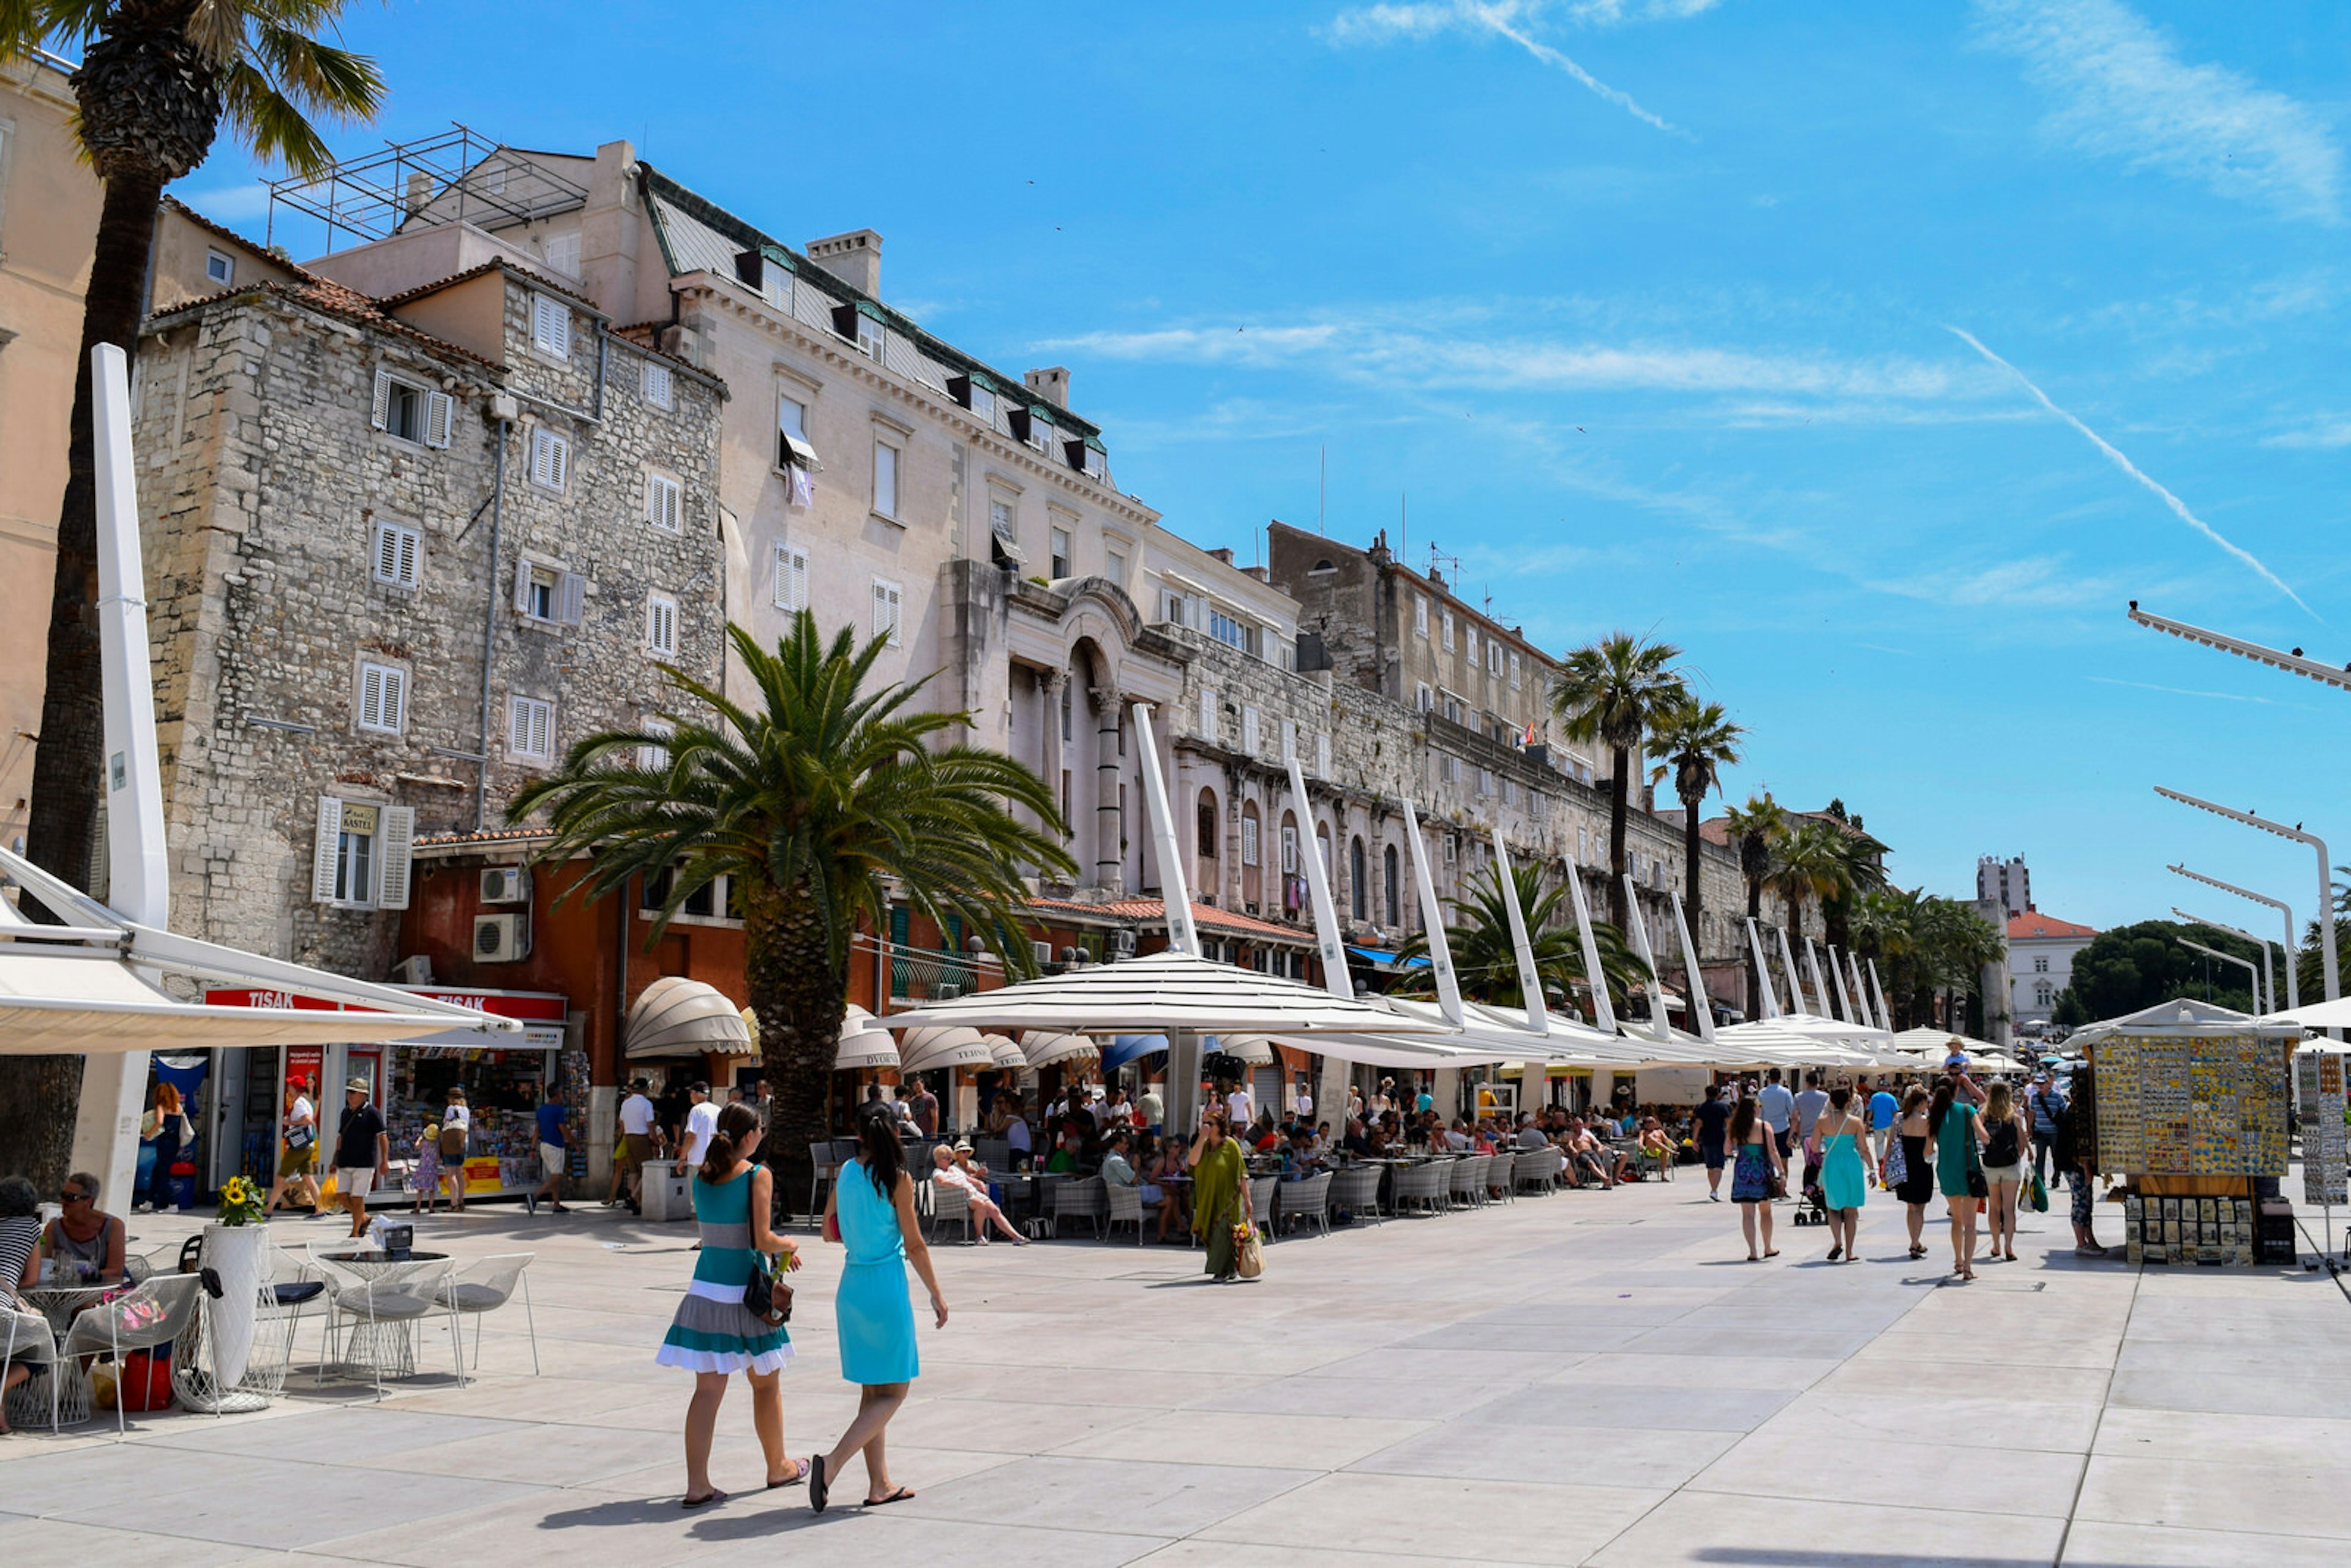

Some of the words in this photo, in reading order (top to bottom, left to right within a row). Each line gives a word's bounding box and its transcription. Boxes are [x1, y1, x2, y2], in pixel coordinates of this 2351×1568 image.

[343, 819, 372, 830] KASTEL
[249, 991, 294, 1009] TISAK
[437, 995, 486, 1011] SAK
